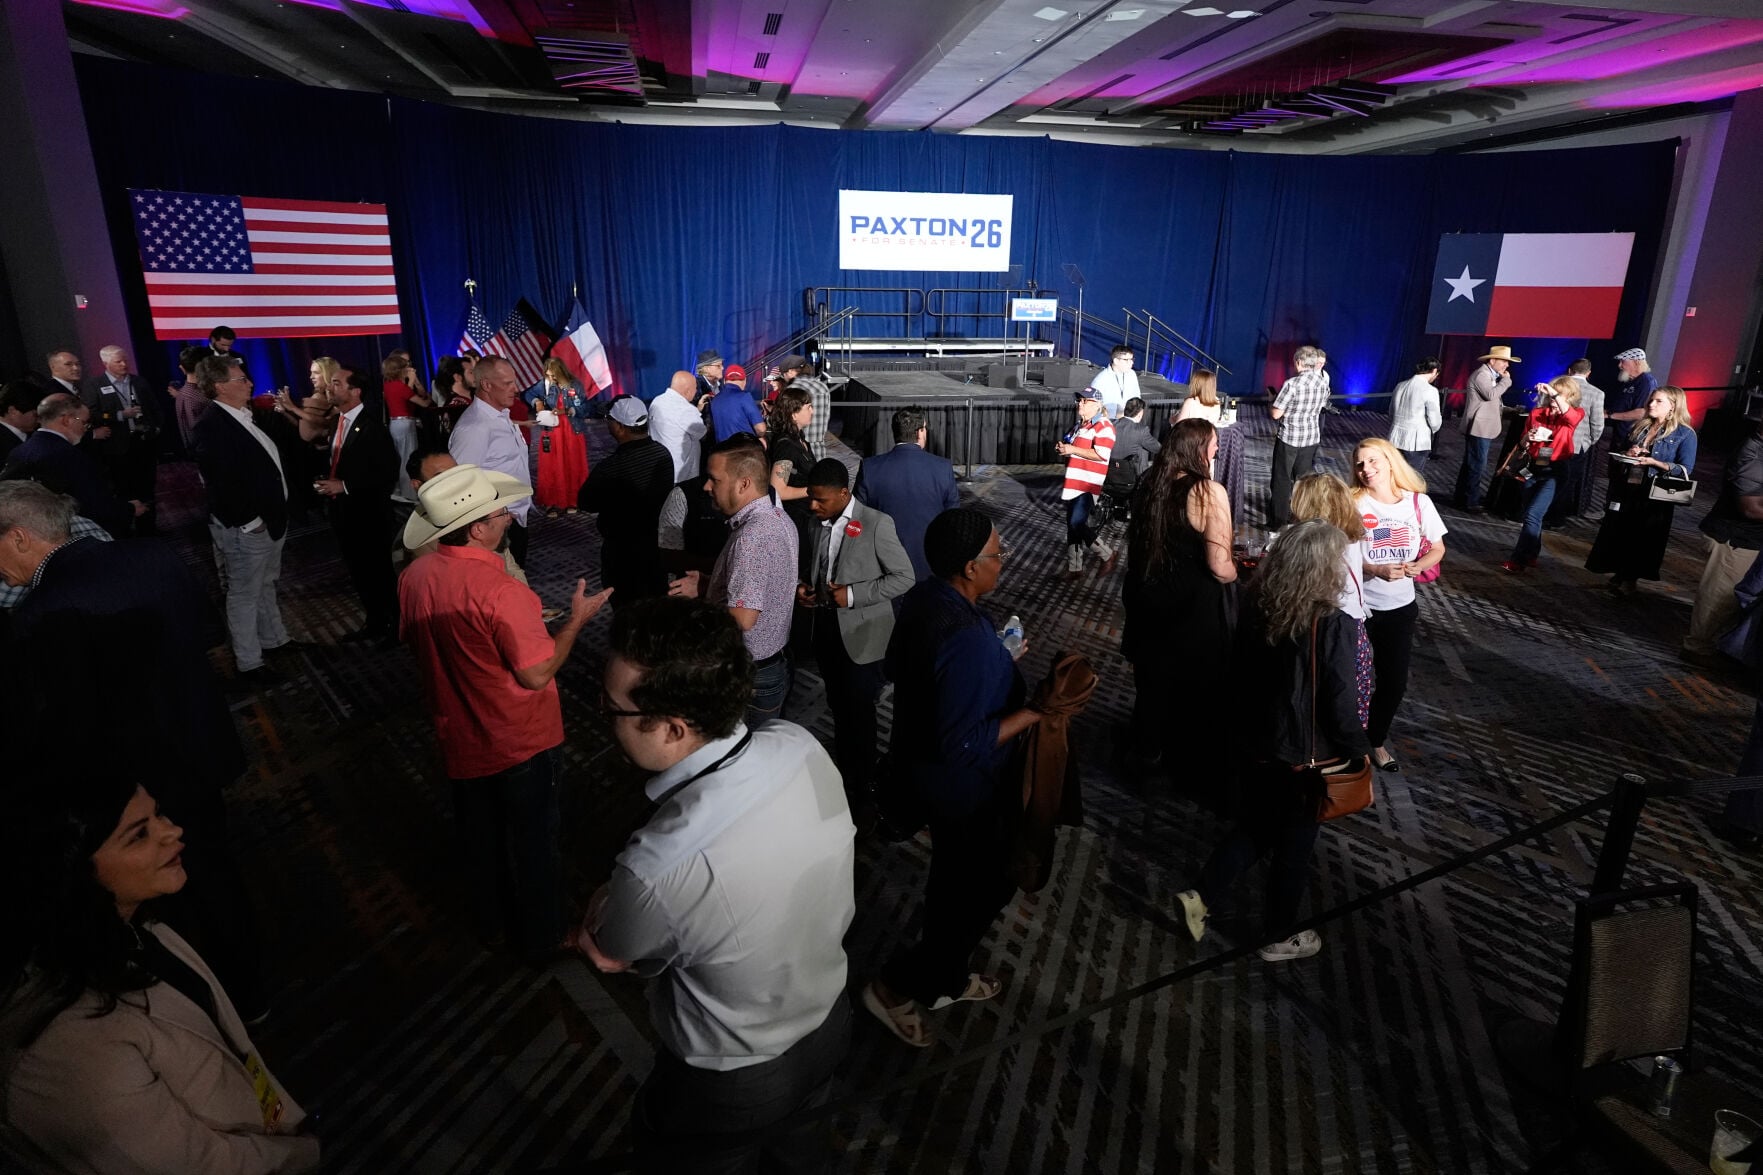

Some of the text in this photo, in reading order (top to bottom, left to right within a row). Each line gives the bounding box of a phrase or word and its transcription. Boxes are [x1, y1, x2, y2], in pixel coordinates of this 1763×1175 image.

[850, 215, 1003, 248] PAXTON 26
[861, 236, 957, 247] FOR SENATE
[1368, 548, 1387, 560] OLD
